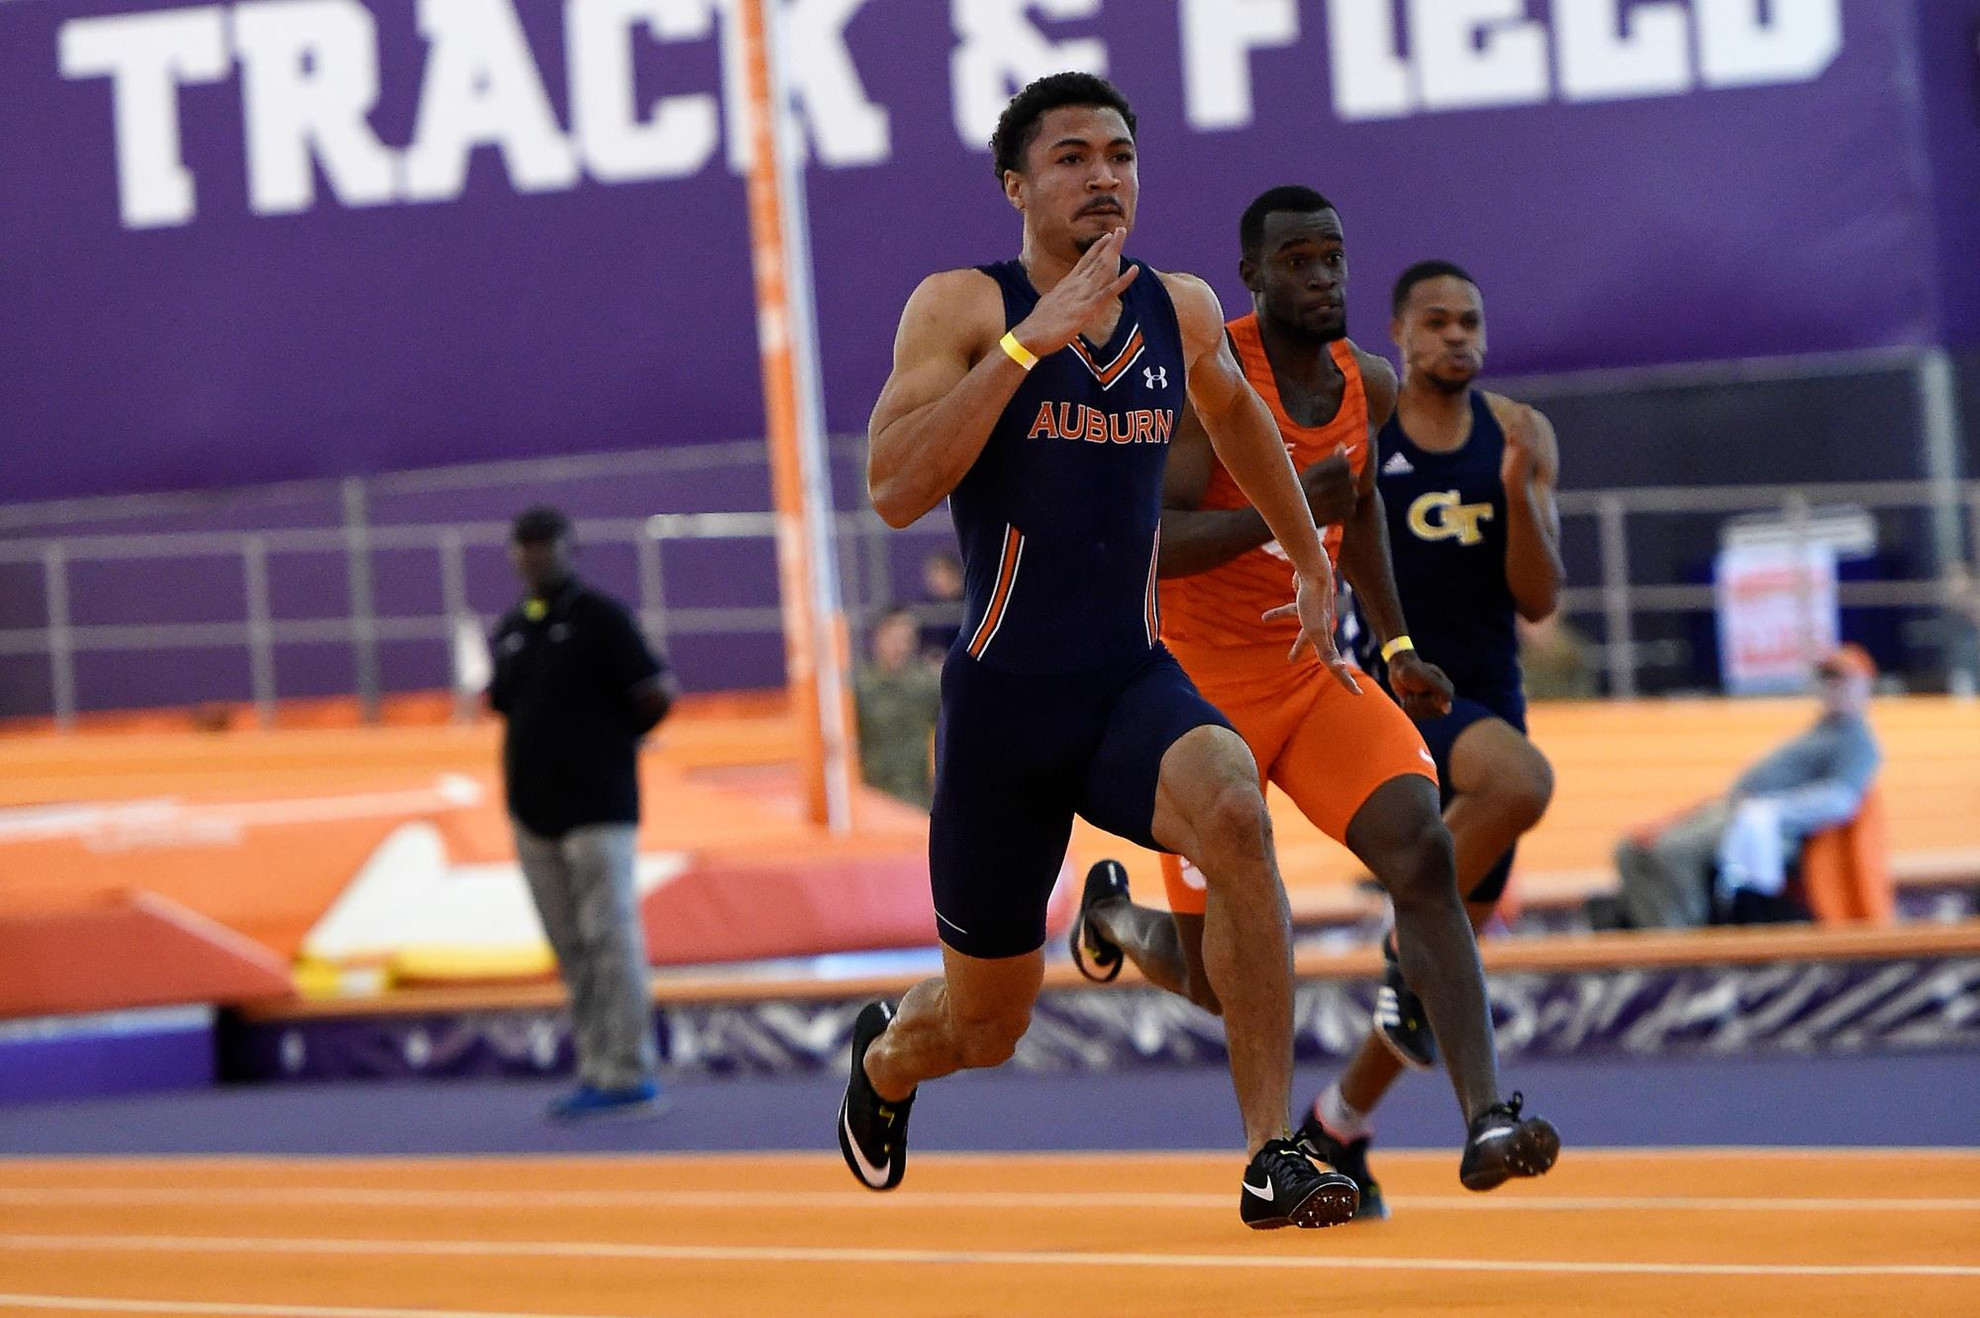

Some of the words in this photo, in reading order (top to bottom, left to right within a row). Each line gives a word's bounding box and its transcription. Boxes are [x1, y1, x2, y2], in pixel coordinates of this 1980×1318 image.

[58, 0, 892, 229] TRACK
[948, 0, 1109, 151] &
[1027, 401, 1174, 444] AUBURN
[1406, 488, 1495, 546] GT
